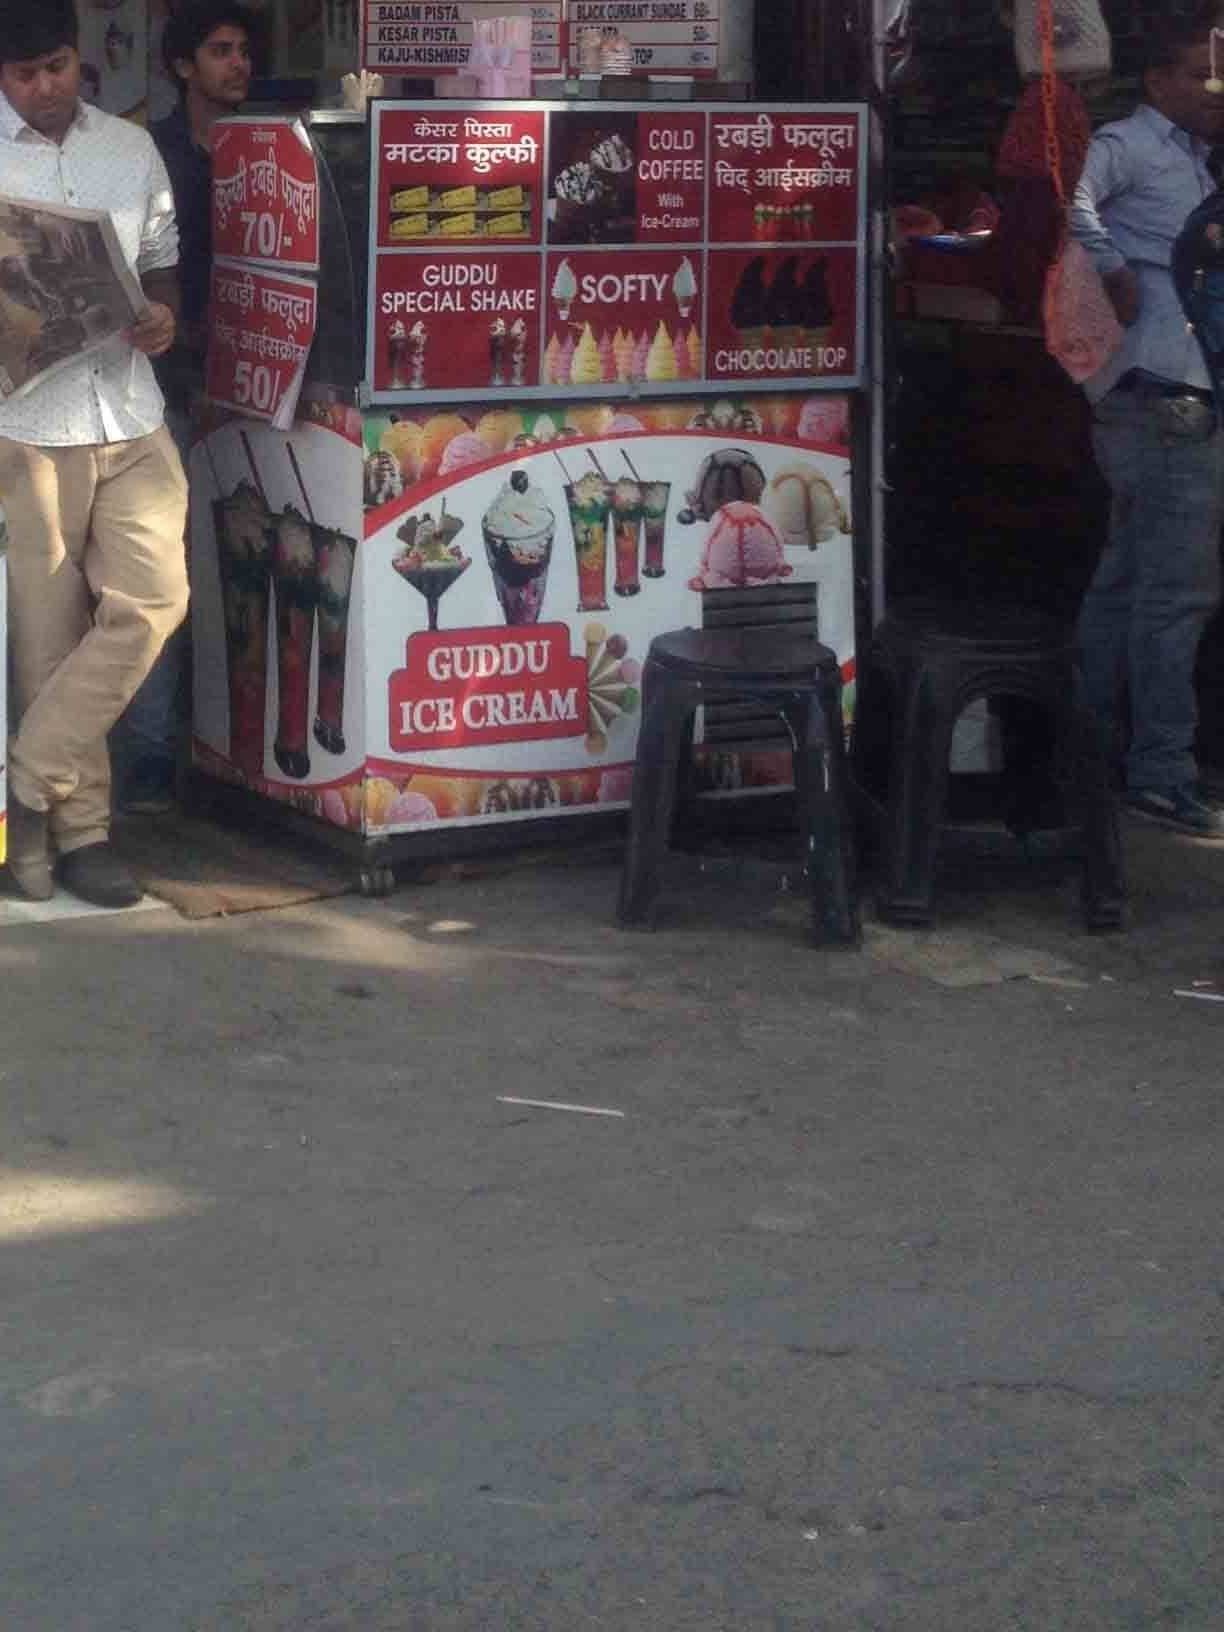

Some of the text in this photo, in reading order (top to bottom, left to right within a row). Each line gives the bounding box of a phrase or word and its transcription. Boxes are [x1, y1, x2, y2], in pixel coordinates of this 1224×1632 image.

[378, 6, 460, 21] BADAM PISTA
[378, 26, 458, 42] KESAR PISTA
[413, 117, 512, 138] केसर पिस्ता
[648, 129, 695, 151] COLD
[713, 113, 855, 158] रबड़ी फलूदा
[384, 135, 538, 173] मटका कुल्फी
[638, 159, 704, 180] COFFEE
[755, 159, 853, 192] आईसक्रीम
[657, 194, 684, 207] With
[240, 212, 292, 256] 70/-
[422, 264, 497, 286] GUDDU
[381, 289, 536, 314] SPECIAL SHAKE
[579, 274, 671, 305] SOFTY
[262, 287, 313, 332] फलूदा
[714, 347, 848, 373] CHOCOLATE TOP
[426, 640, 552, 682] GUDDU
[399, 687, 579, 736] ICE CREAM
